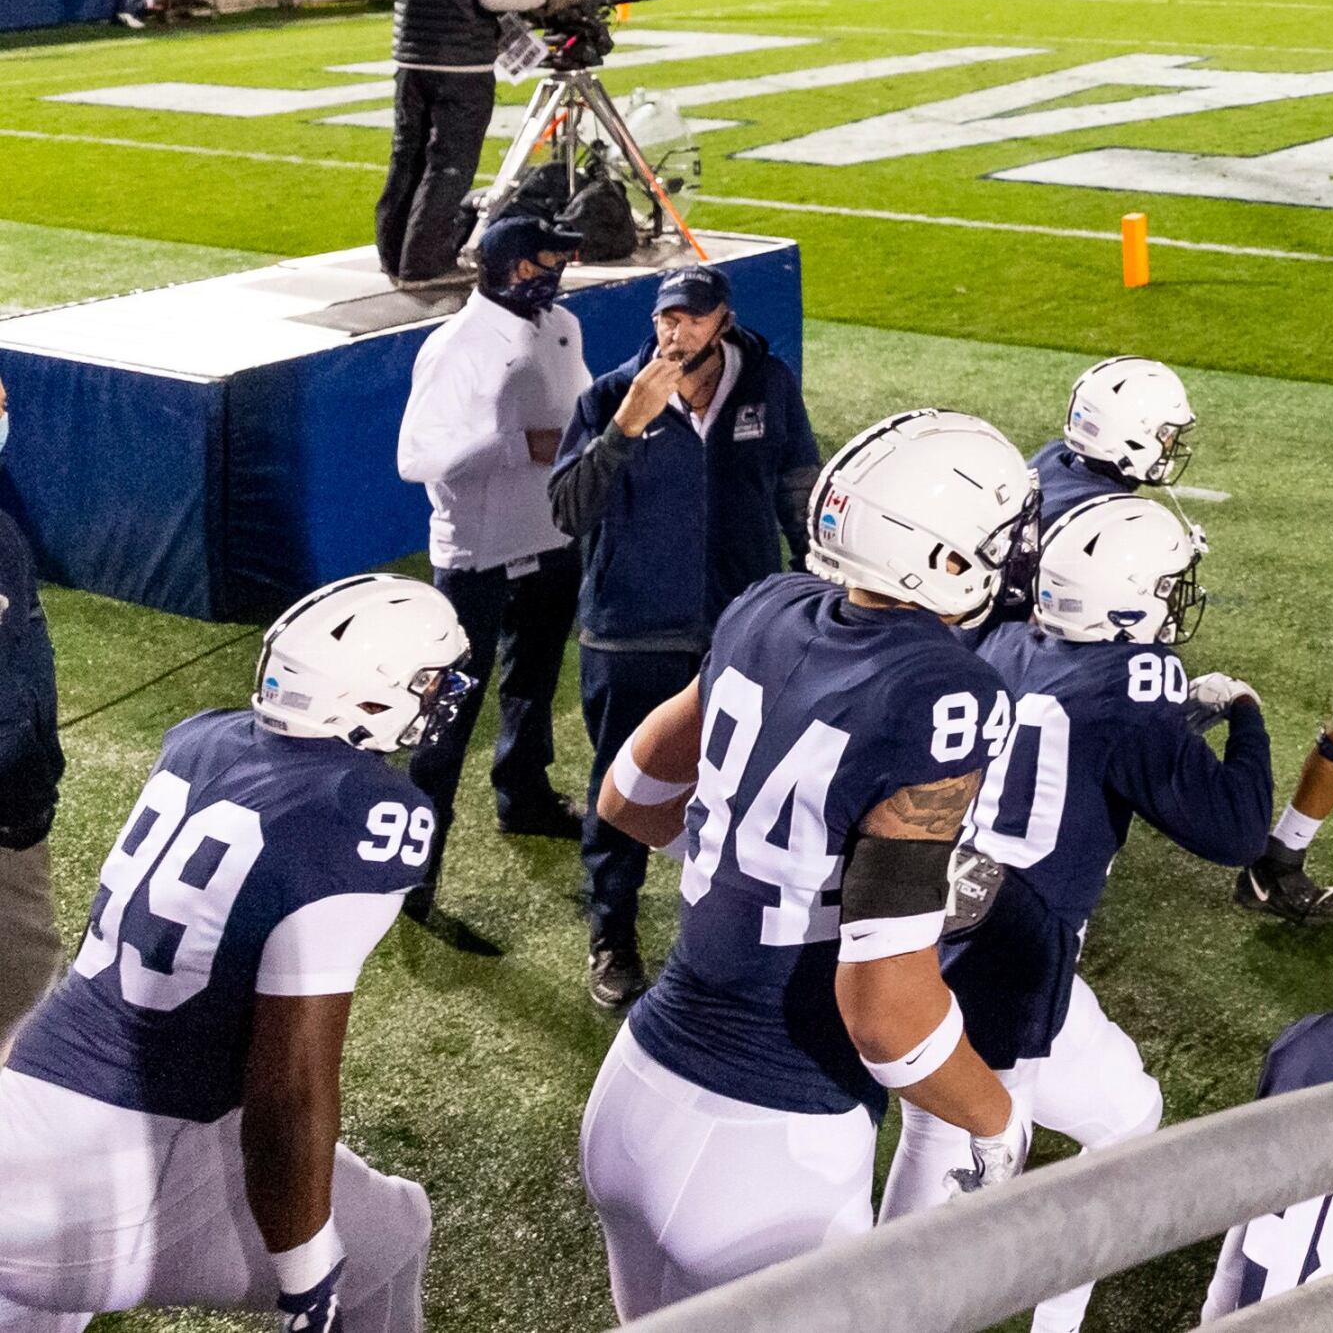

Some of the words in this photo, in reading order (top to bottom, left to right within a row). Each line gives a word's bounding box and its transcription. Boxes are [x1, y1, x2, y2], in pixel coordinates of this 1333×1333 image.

[1127, 652, 1190, 703] 80
[930, 689, 1012, 764] 84
[357, 800, 435, 867] 99
[680, 666, 850, 947] 84
[74, 770, 264, 1011] 99
